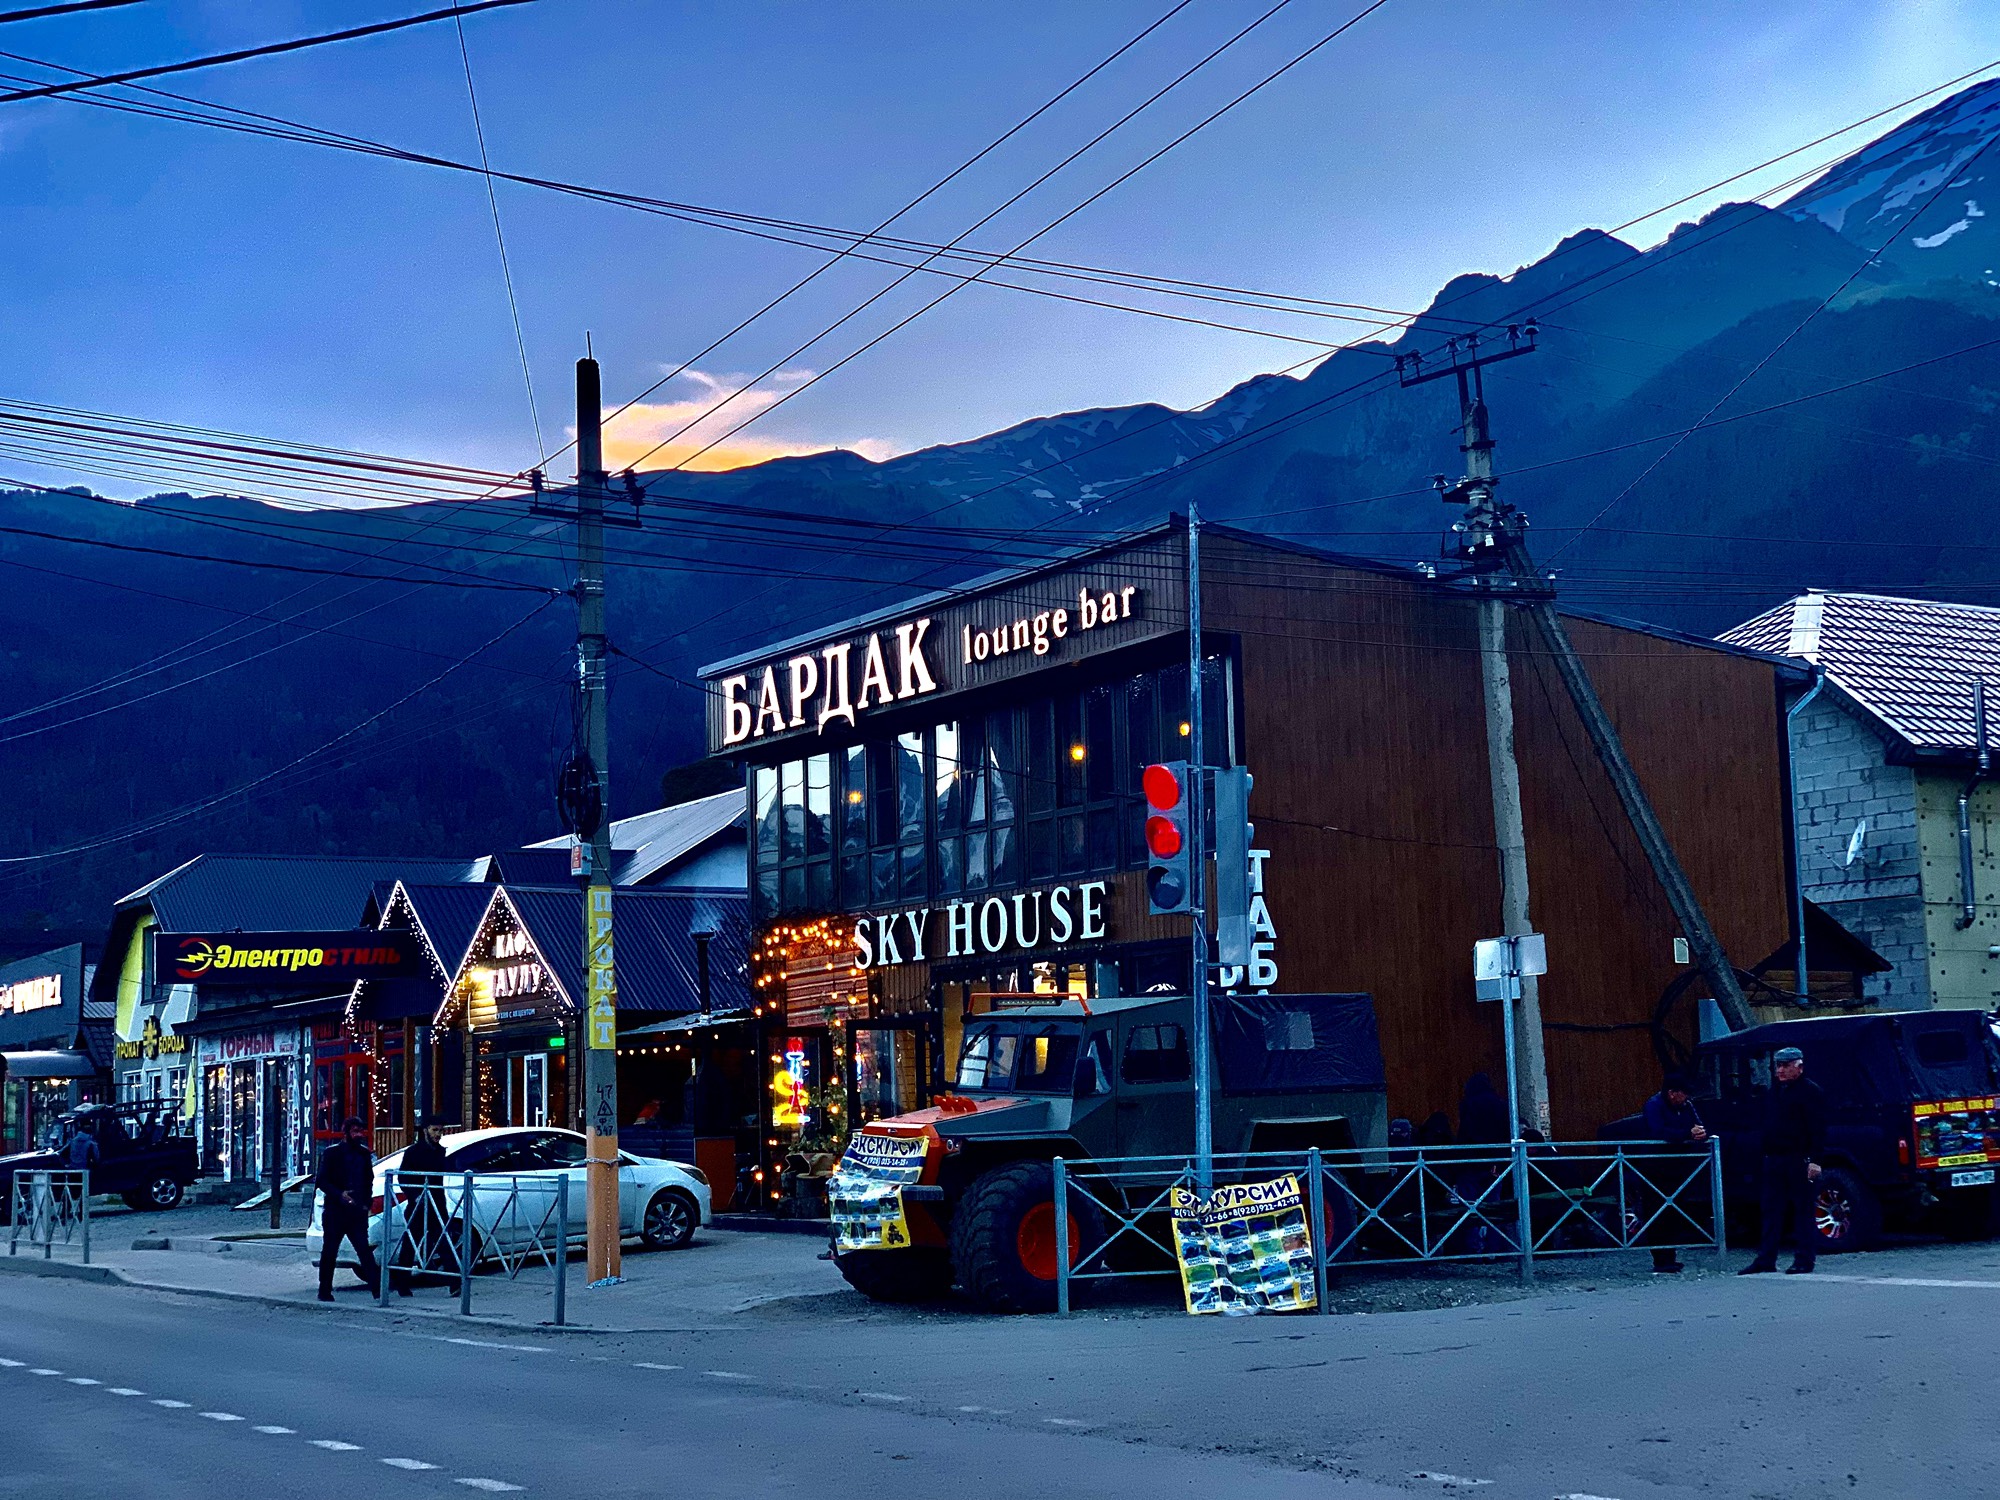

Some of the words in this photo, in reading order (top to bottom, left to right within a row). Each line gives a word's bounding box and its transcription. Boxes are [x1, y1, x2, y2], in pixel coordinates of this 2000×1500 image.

[963, 608, 1068, 665] lounge
[1079, 585, 1135, 630] bar
[722, 618, 936, 745] БАРДАК
[213, 944, 401, 972] Электростиль
[854, 909, 930, 970] SKY
[946, 881, 1107, 956] HOUSE
[1247, 849, 1279, 996] ТАБ
[593, 890, 614, 1045] ПРОКАТ
[116, 1041, 139, 1058] ПРОКАТ
[158, 1035, 185, 1054] БОРОДА
[302, 1026, 311, 1176] ПРОКАТ
[851, 1135, 923, 1156] ЭКСКУРСИИ
